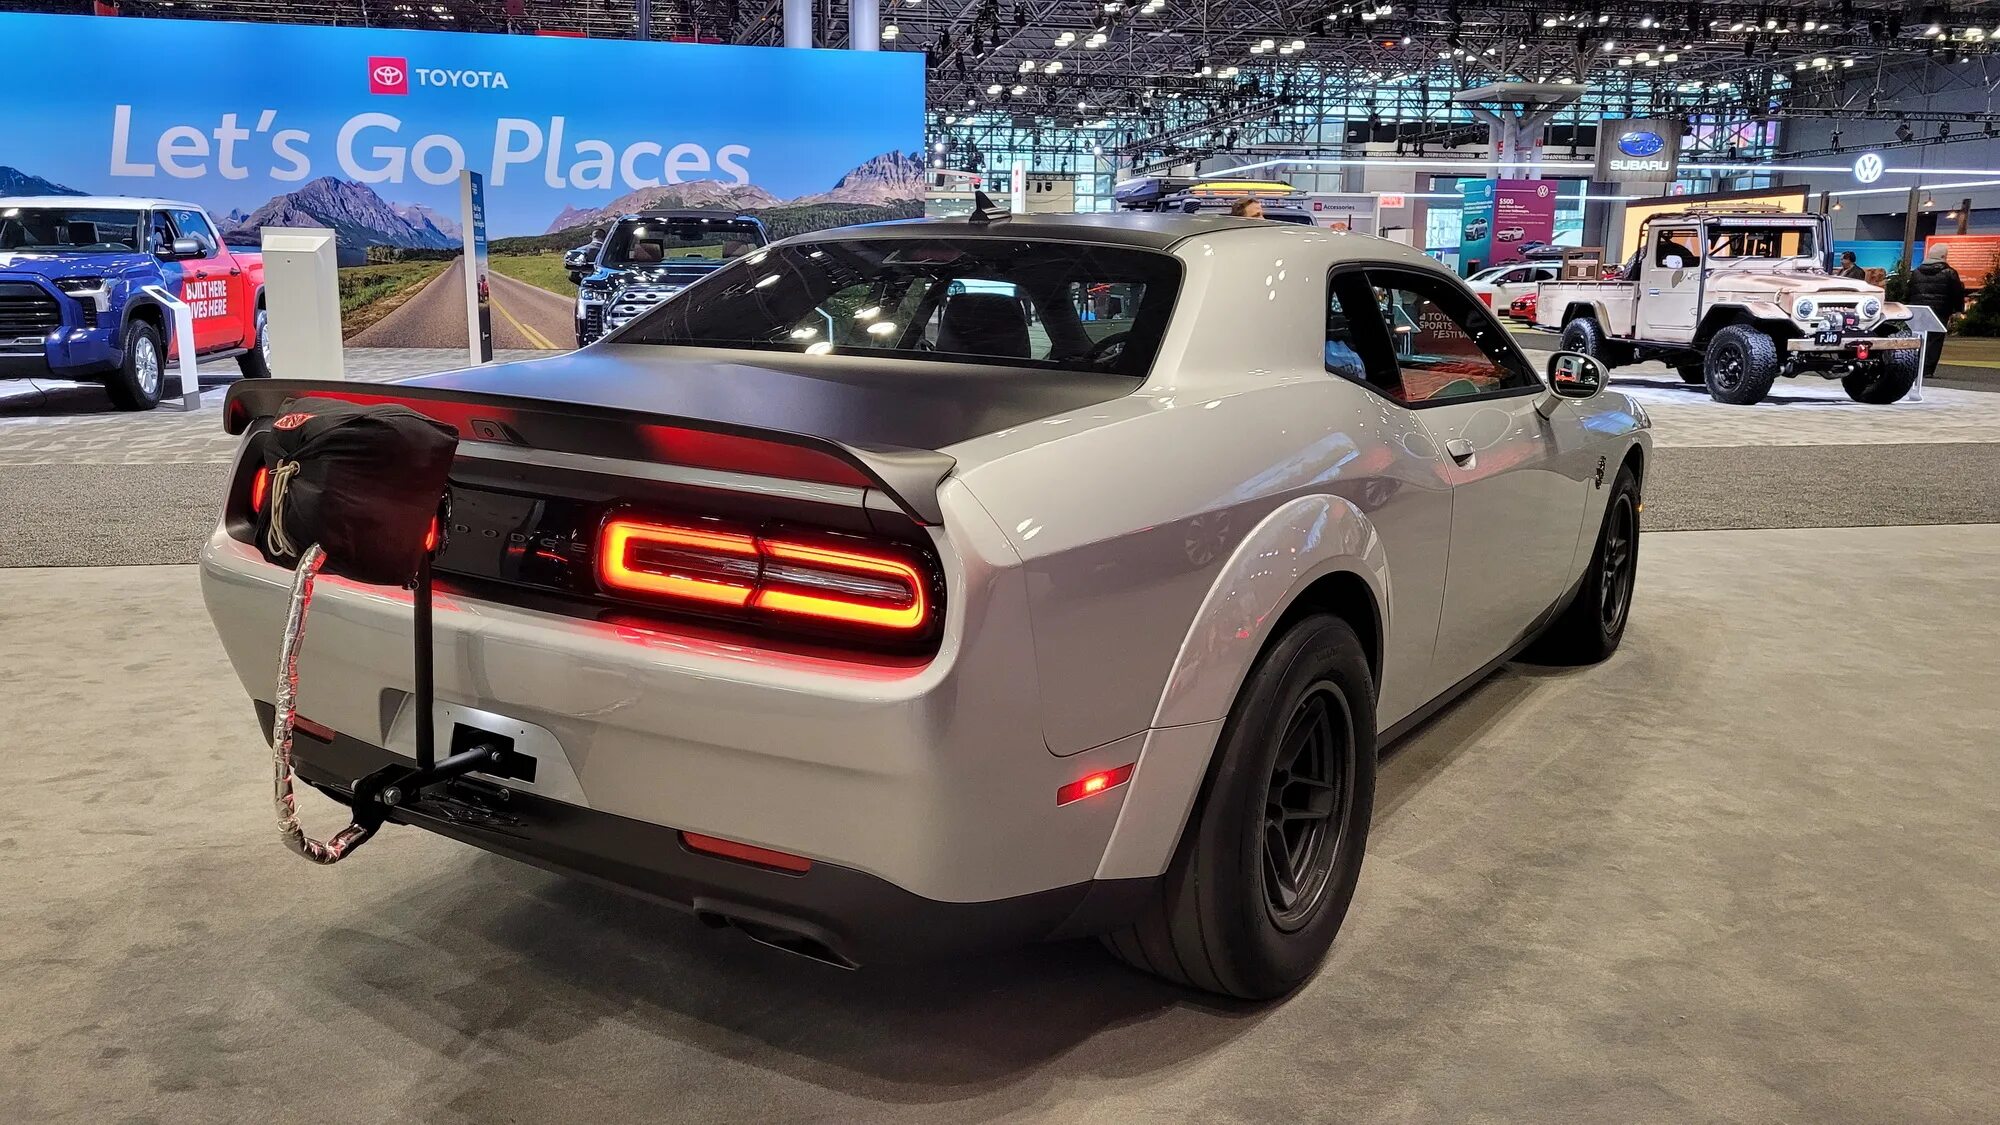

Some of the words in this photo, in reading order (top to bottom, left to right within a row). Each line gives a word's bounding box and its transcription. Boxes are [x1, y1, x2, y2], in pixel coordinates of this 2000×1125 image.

[415, 68, 509, 89] TOYOTA
[110, 104, 311, 182] Let’s
[336, 112, 466, 186] Go
[490, 115, 751, 190] Places
[1610, 160, 1670, 171] SUBARU
[186, 281, 207, 300] BUILT
[208, 280, 227, 298] HERE
[188, 300, 207, 319] IVES
[208, 298, 227, 317] HERE
[1419, 321, 1453, 330] SPORTS
[1820, 334, 1838, 343] FJ49
[454, 523, 588, 553] DODGE
